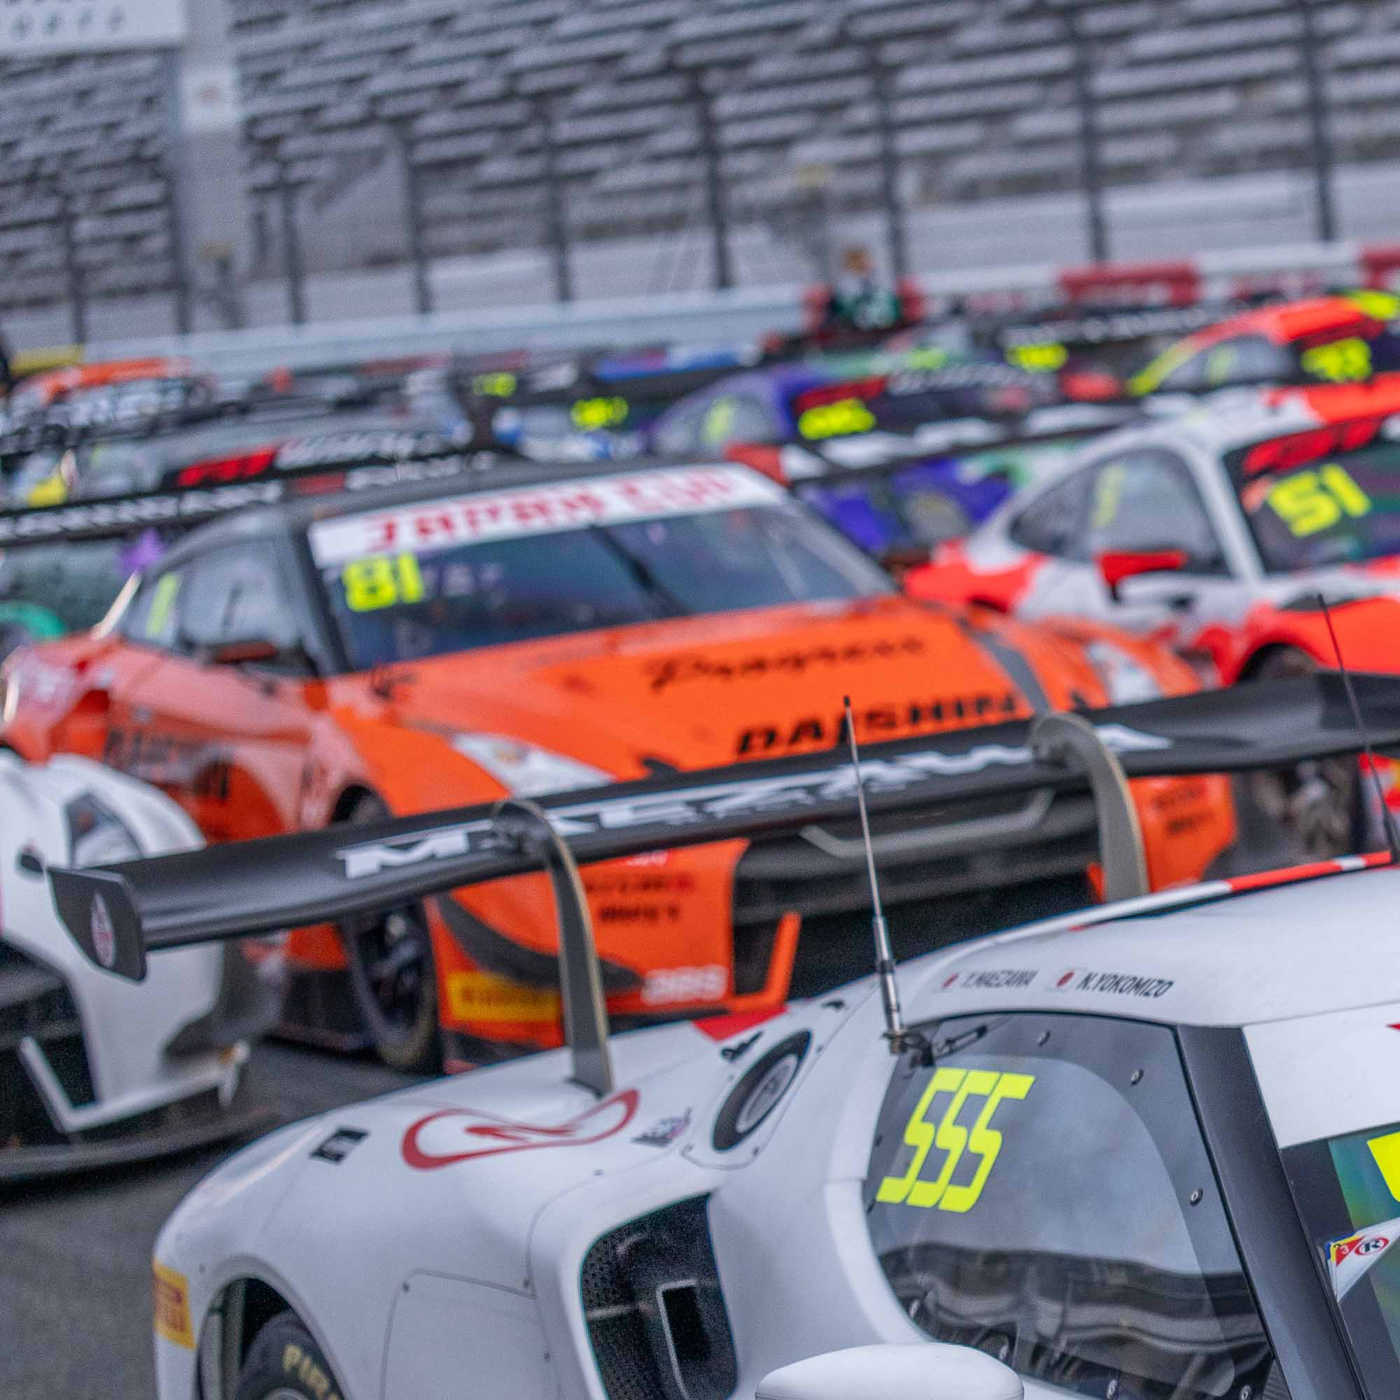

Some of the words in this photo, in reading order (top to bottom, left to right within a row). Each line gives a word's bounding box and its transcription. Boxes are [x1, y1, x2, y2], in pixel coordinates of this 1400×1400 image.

[1269, 464, 1371, 538] 51
[341, 552, 426, 612] 81
[1076, 973, 1176, 999] N.YOKOMIZO
[875, 1067, 1036, 1214] 555
